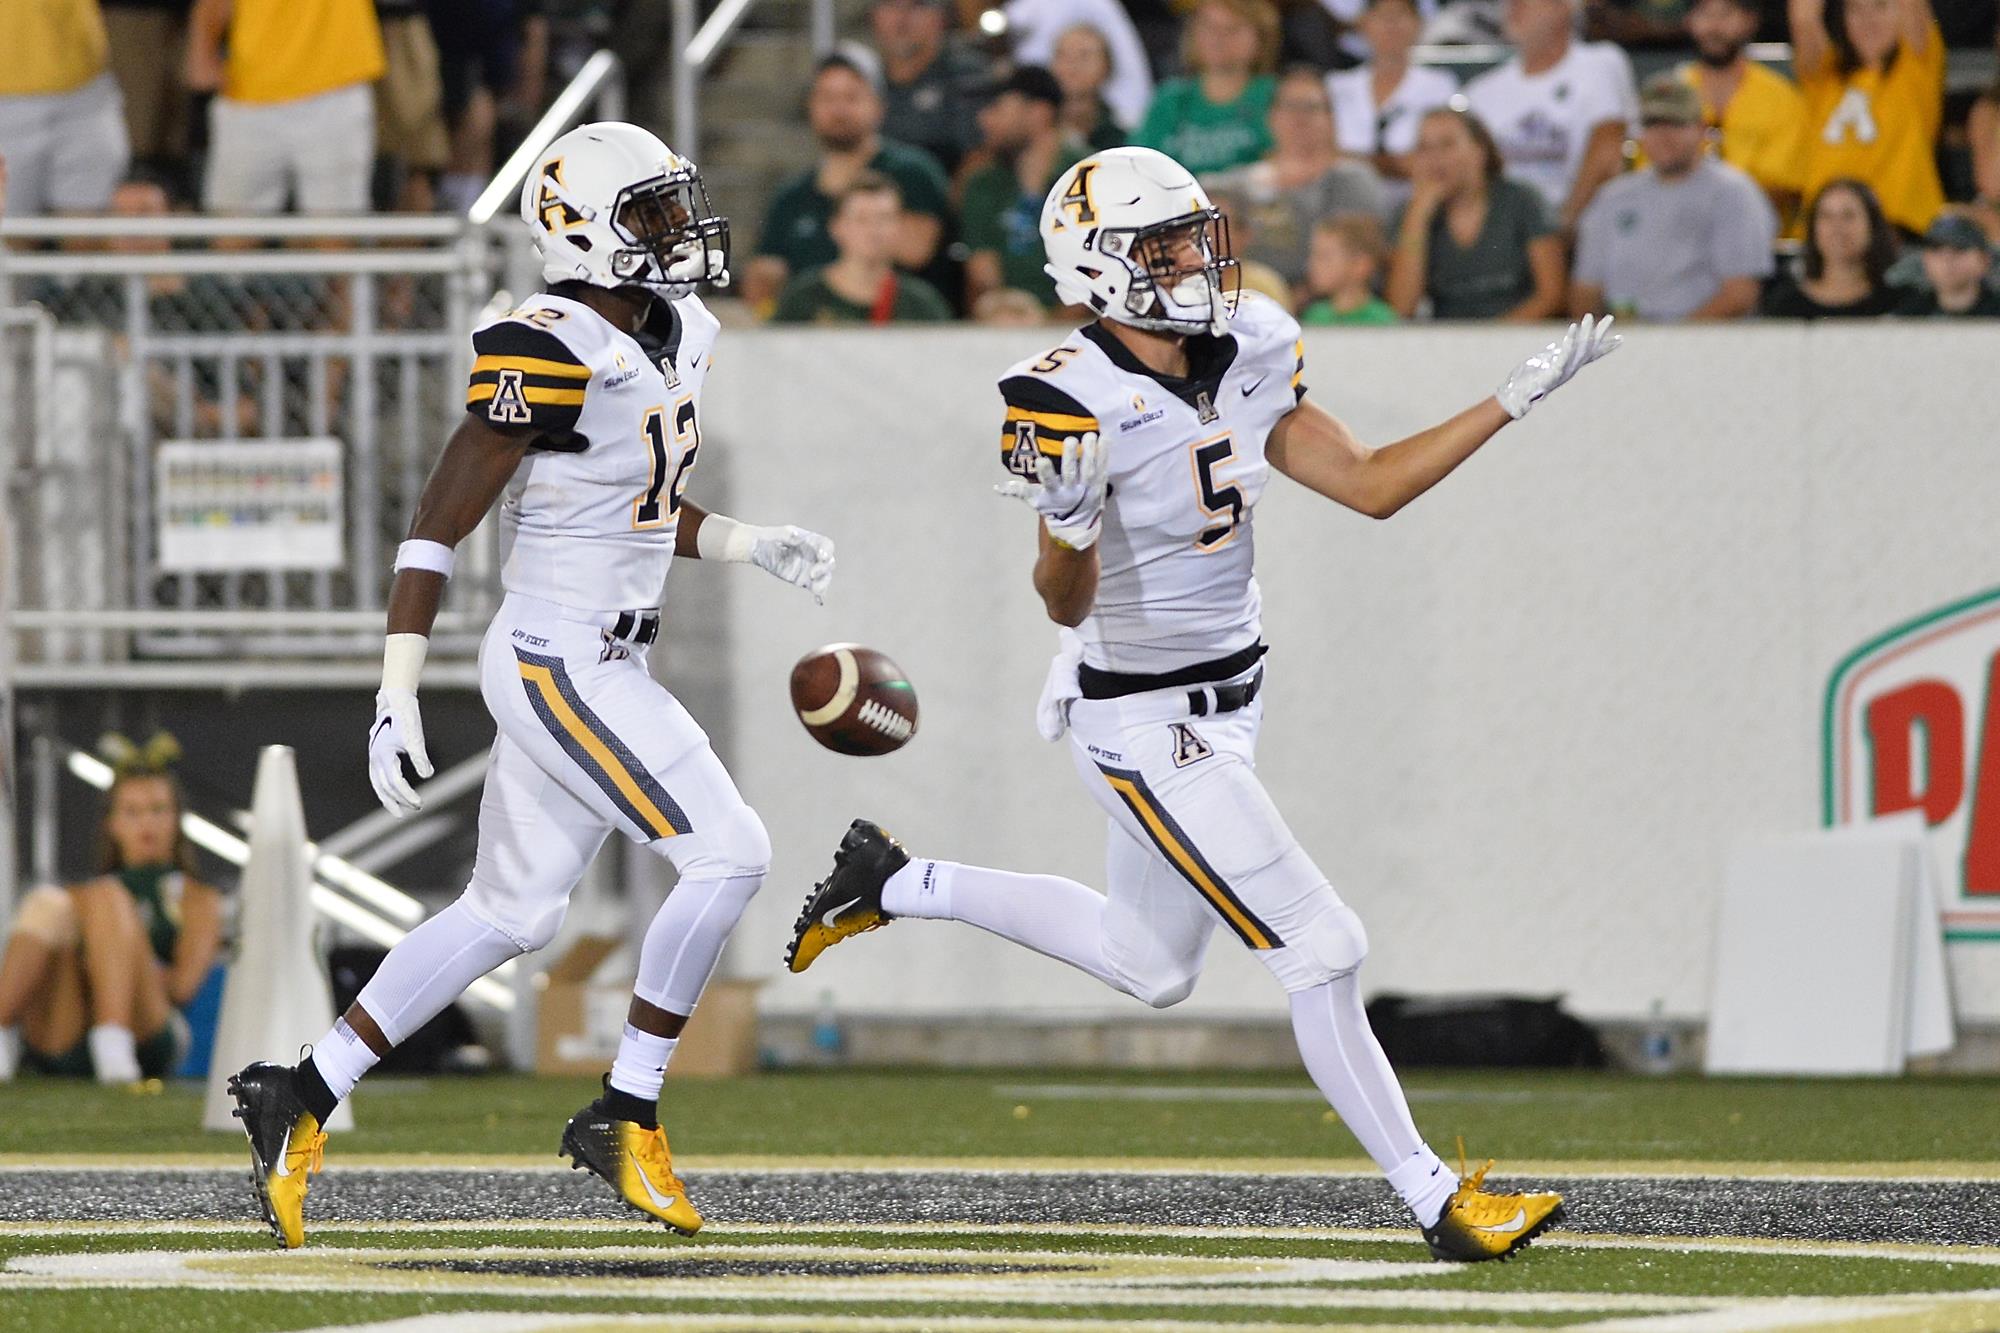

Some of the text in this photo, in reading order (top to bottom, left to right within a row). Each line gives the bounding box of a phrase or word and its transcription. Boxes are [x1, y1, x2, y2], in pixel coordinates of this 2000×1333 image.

[538, 155, 590, 235] A
[1051, 162, 1102, 233] A
[661, 357, 681, 389] A
[1029, 346, 1082, 374] 5
[488, 368, 532, 423] A
[1196, 391, 1220, 425] A
[632, 394, 701, 530] 12
[1009, 420, 1042, 475] A
[1188, 429, 1248, 555] 5
[525, 634, 550, 647] STATE
[1168, 721, 1215, 769] A
